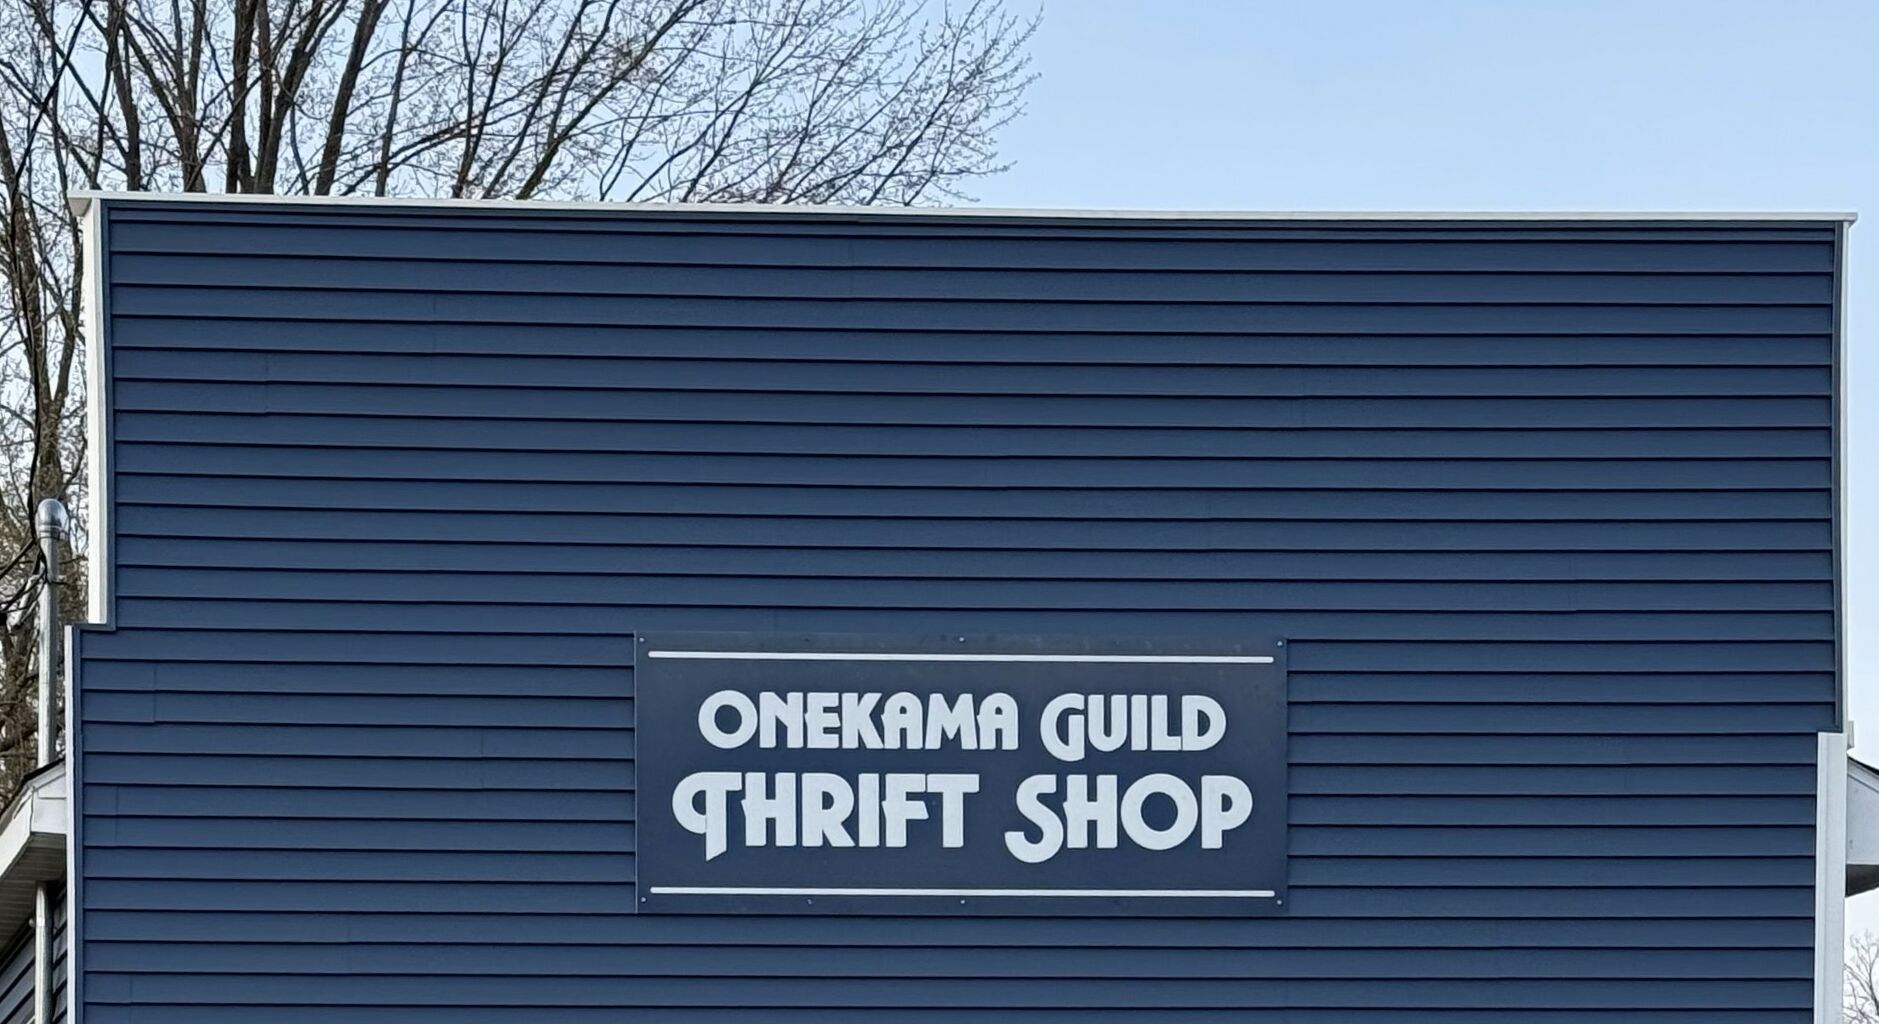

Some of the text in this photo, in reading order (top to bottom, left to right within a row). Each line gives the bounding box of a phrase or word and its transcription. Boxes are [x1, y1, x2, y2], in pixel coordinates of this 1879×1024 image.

[698, 689, 1227, 762] ONEKAMA GUILD
[671, 772, 1254, 864] THRIFT SHOP
